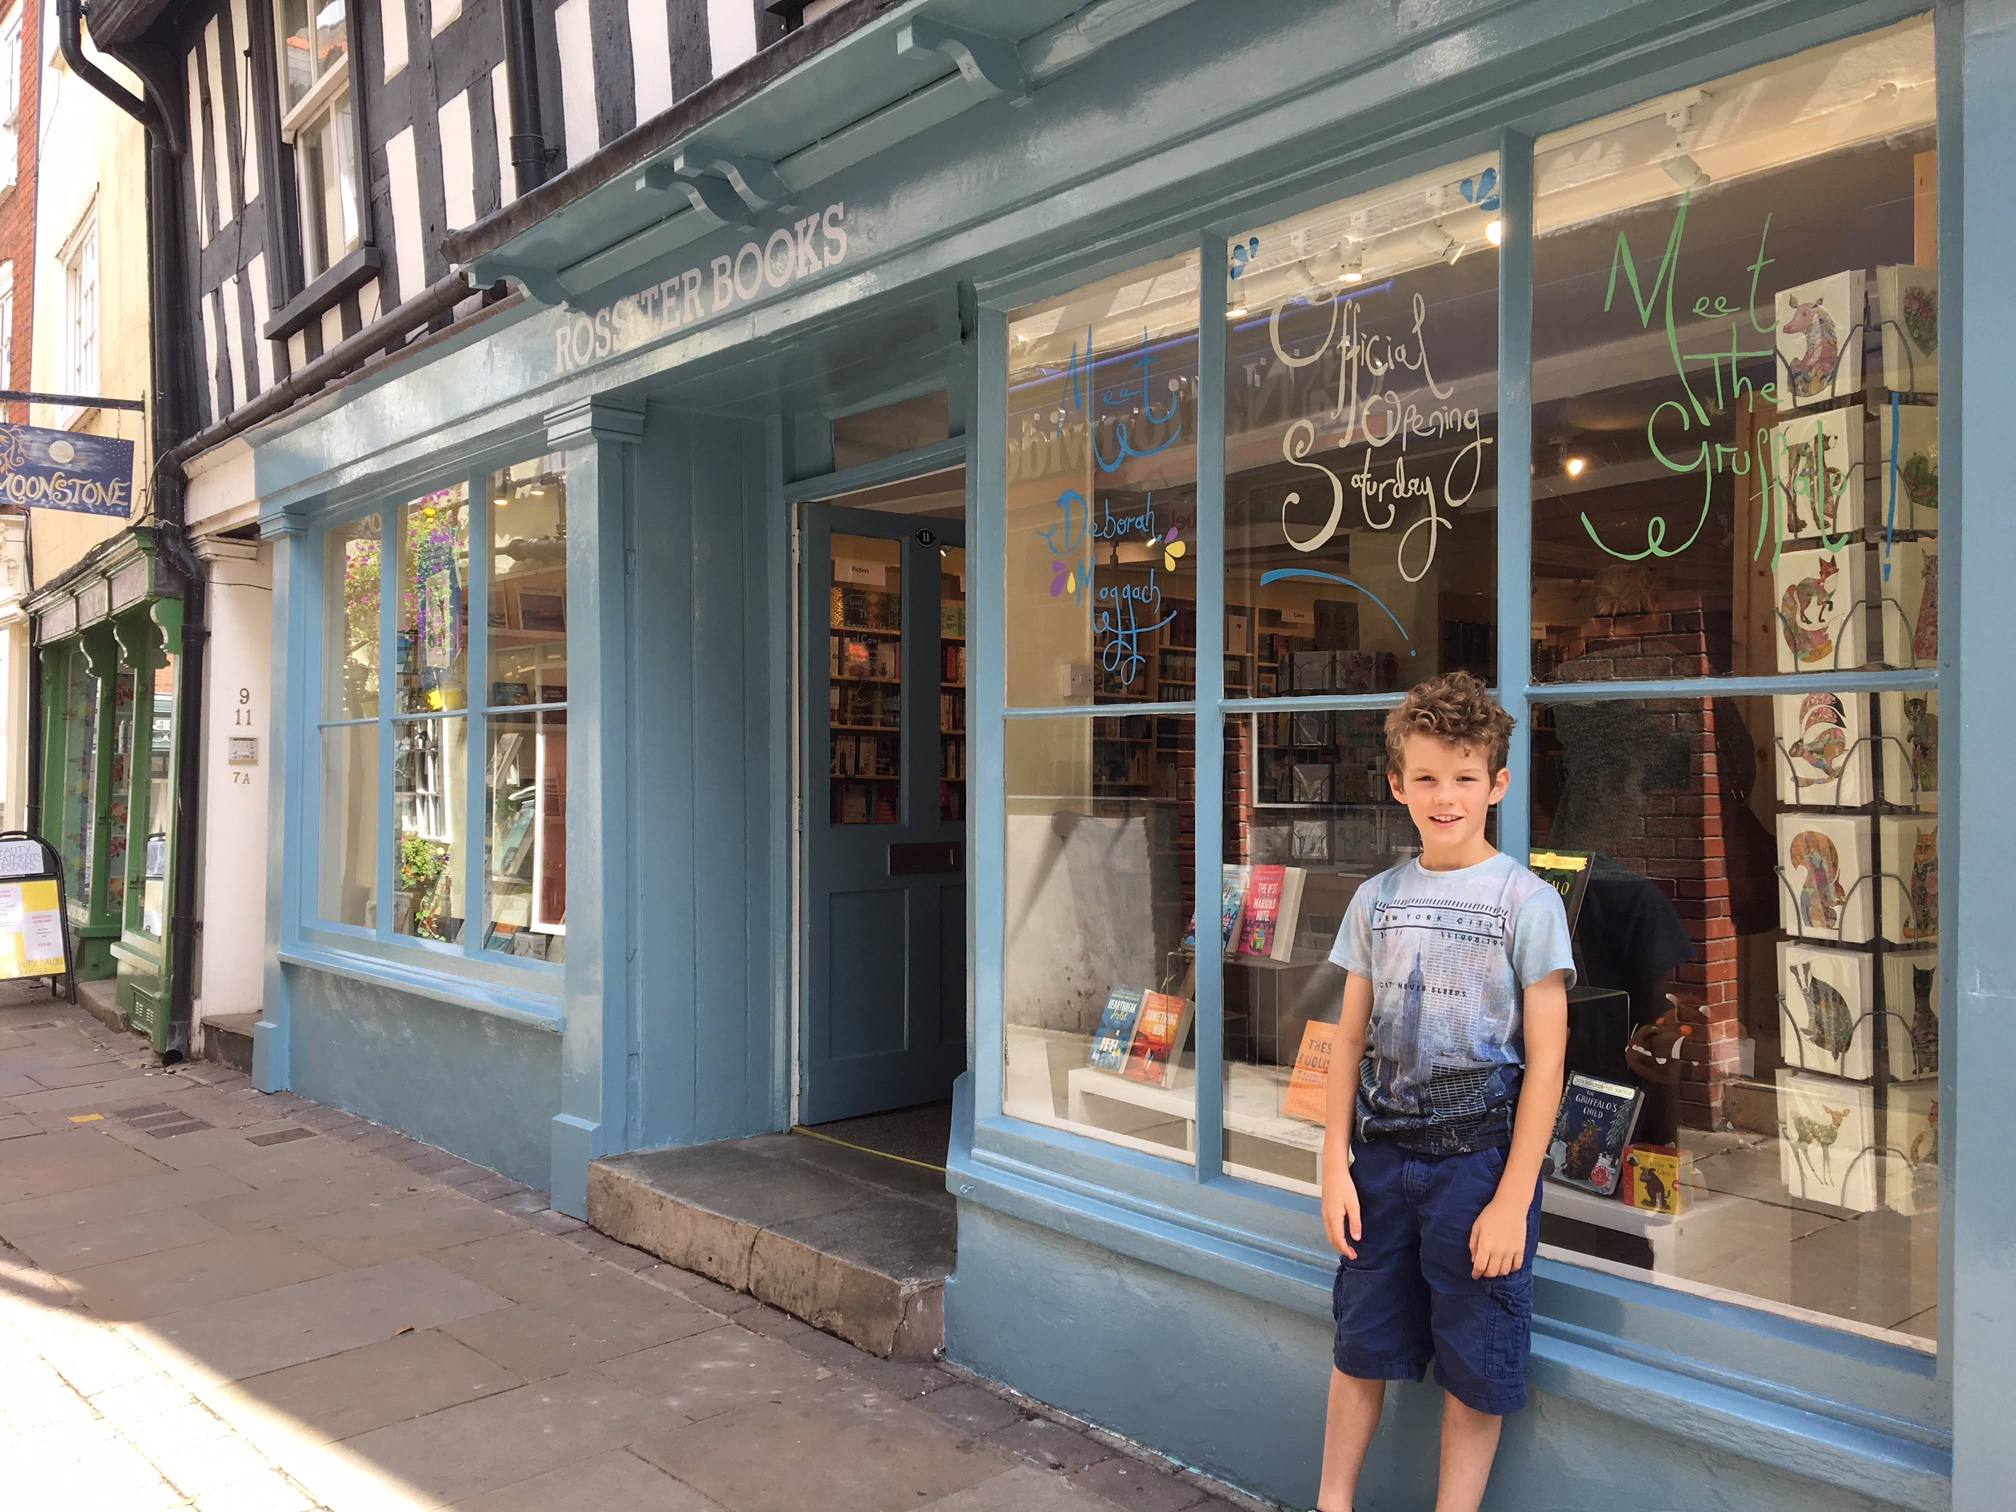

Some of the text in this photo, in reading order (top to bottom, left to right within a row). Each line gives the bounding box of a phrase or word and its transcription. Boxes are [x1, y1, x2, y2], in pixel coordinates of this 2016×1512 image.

[711, 201, 849, 312] BOOKS
[1604, 190, 1779, 427] Meet
[1057, 323, 1182, 474] Meet
[1269, 285, 1454, 449] Official
[1683, 321, 1785, 413] The
[1361, 387, 1494, 508] Opening
[1580, 400, 1850, 572] Gruffalo
[0, 471, 131, 506] MOONSTONE
[1036, 489, 1162, 556] Deborah
[1281, 419, 1453, 583] Saturday
[851, 565, 869, 574] Fiction
[1076, 556, 1178, 686] Moggach
[235, 708, 252, 726] 11
[239, 687, 250, 705] 9
[233, 772, 251, 785] 7A
[1406, 913, 1443, 922] YORK
[1457, 917, 1494, 929] CITY
[1575, 1093, 1619, 1113] GRUFFALO'S
[1582, 1106, 1604, 1119] CHILD
